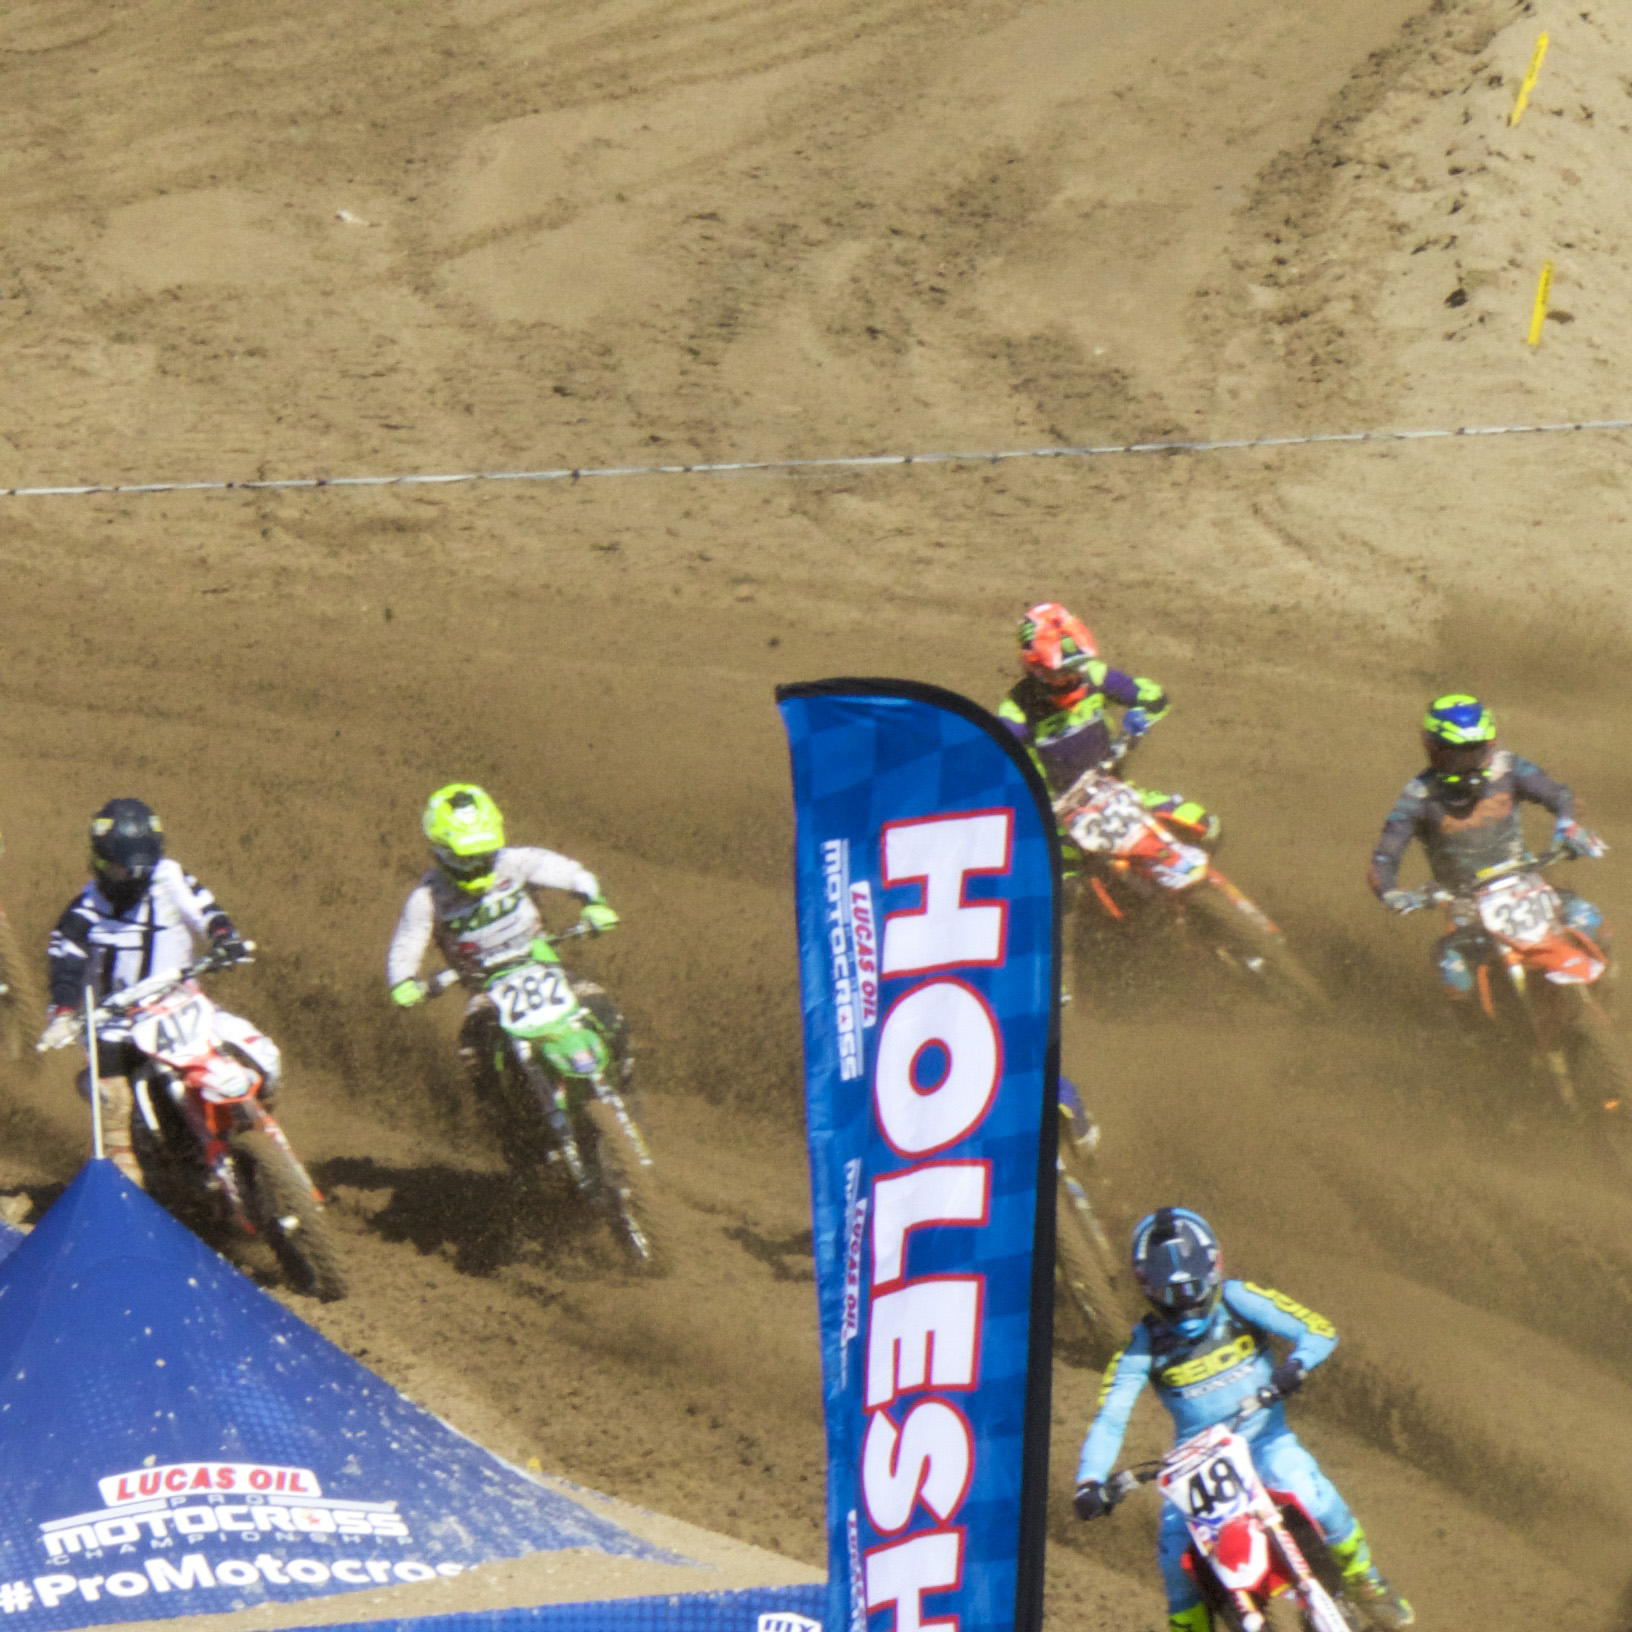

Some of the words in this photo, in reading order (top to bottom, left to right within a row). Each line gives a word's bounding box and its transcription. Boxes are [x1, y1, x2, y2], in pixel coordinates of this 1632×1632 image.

[851, 889, 875, 974] LUCAS
[822, 838, 858, 1081] MOTOCROSS
[502, 970, 566, 1024] 282
[861, 979, 877, 1020] OIL
[1161, 1334, 1256, 1388] GEICO
[117, 1466, 236, 1502] LUCAS
[248, 1468, 309, 1493] OIL
[1188, 1458, 1244, 1519] 48
[43, 1504, 410, 1557] MOTOCROSS
[0, 1553, 479, 1614] #ProMotocros
